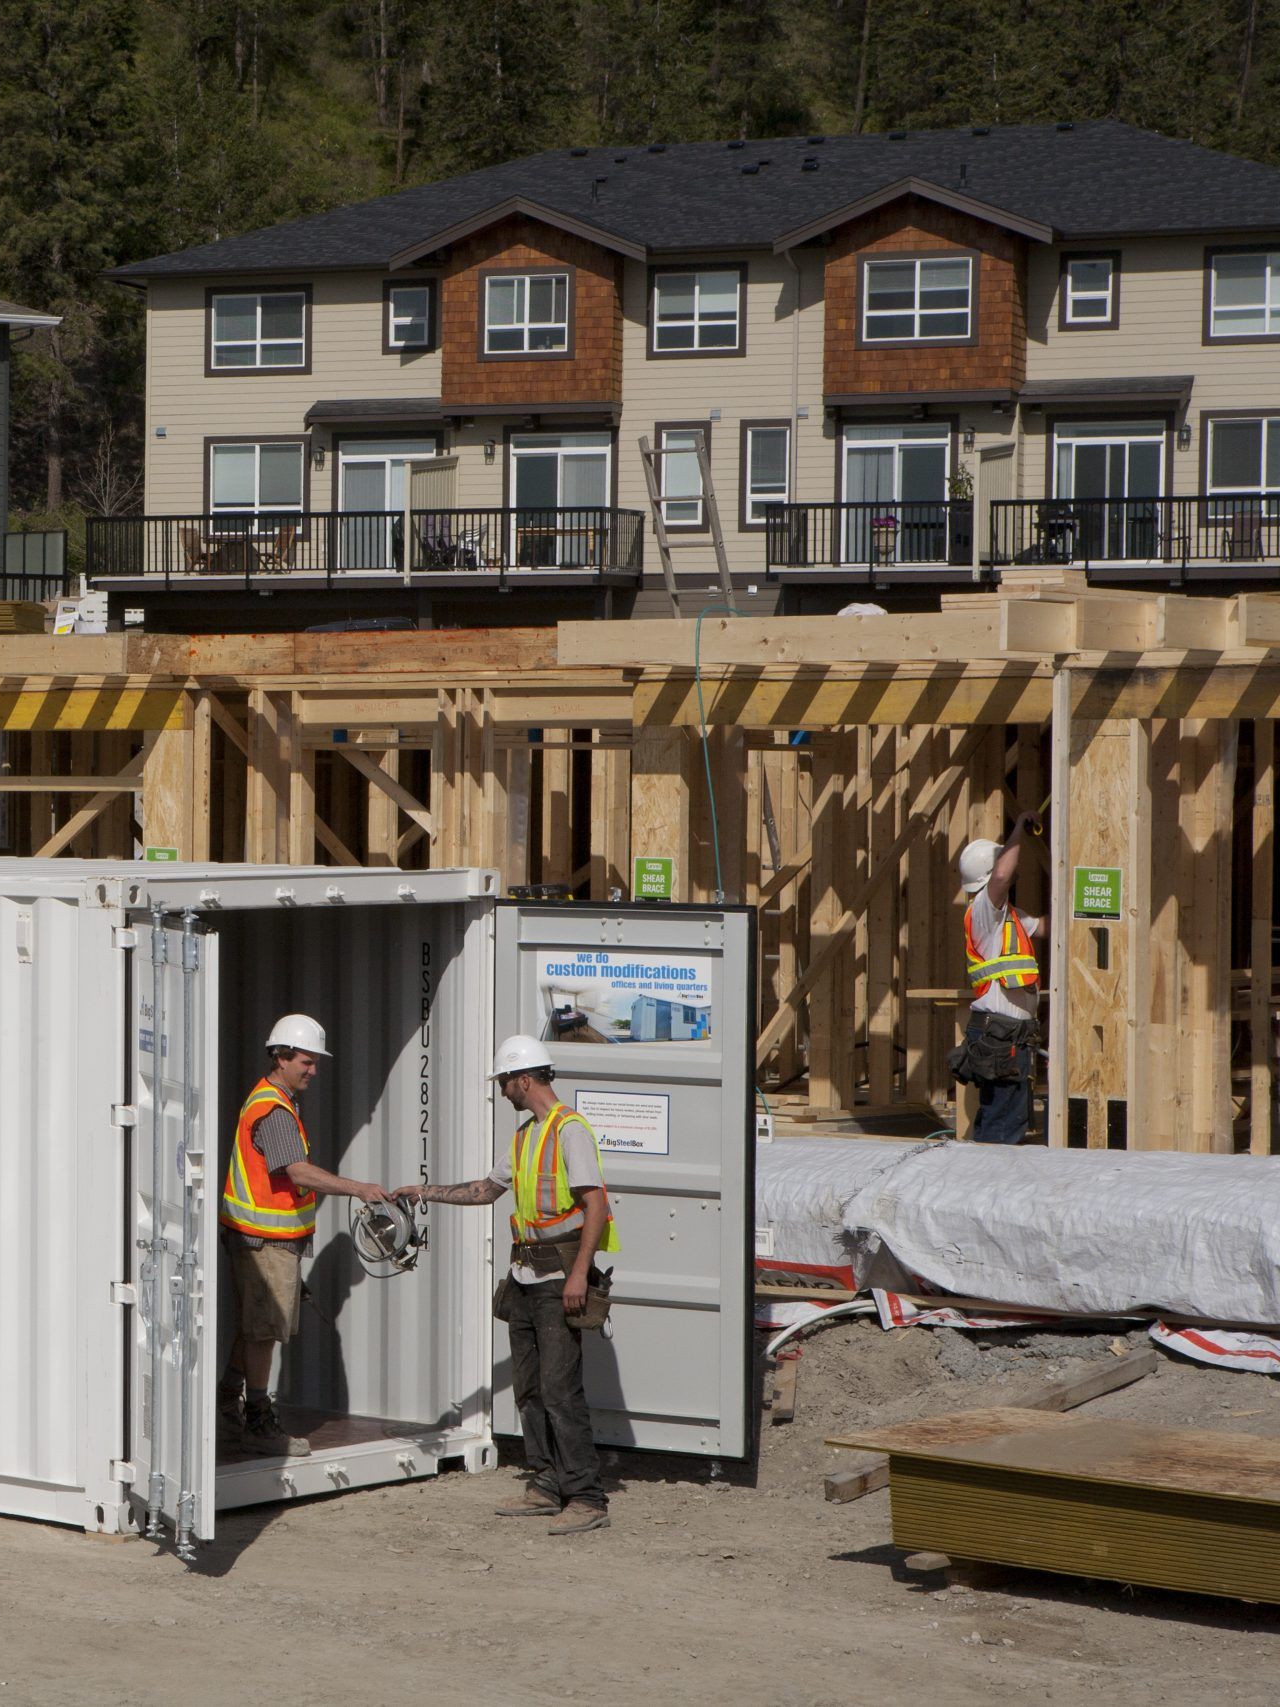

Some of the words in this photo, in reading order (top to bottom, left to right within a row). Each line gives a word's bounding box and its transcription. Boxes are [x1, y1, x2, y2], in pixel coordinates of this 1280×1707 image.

[642, 873, 665, 883] SHEAR
[642, 884, 665, 893] BRACE
[1083, 886, 1112, 897] SHEAR
[1083, 897, 1111, 908] BRACE
[576, 952, 593, 963] we
[595, 952, 609, 964] do
[546, 963, 597, 977] custom
[601, 963, 697, 981] modifications
[611, 980, 637, 989] offices
[654, 981, 675, 991] living
[676, 983, 709, 992] quarters
[606, 1138, 644, 1148] BigSteelBox
